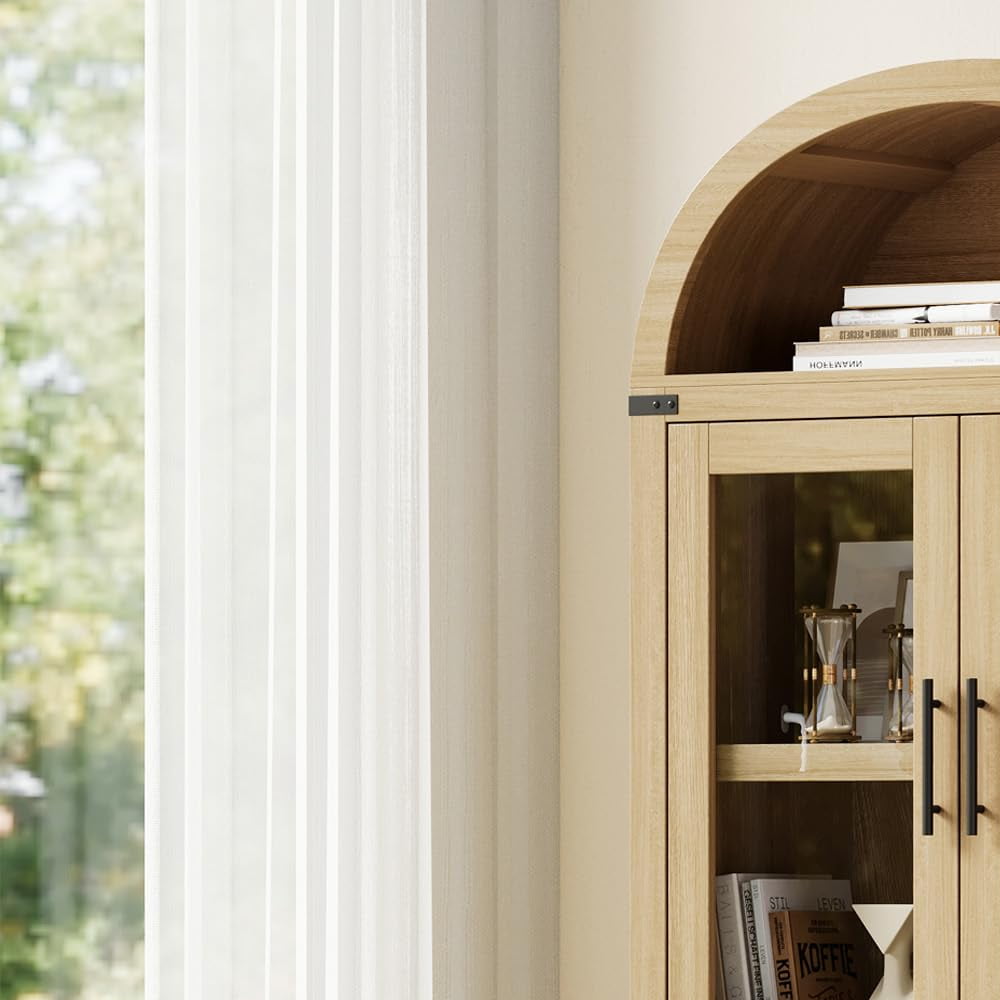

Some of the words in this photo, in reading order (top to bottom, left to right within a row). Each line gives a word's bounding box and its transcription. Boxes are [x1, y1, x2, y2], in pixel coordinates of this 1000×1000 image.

[769, 897, 790, 910] STIL
[816, 897, 847, 911] LEVEN
[797, 943, 857, 979] KOFFIE
